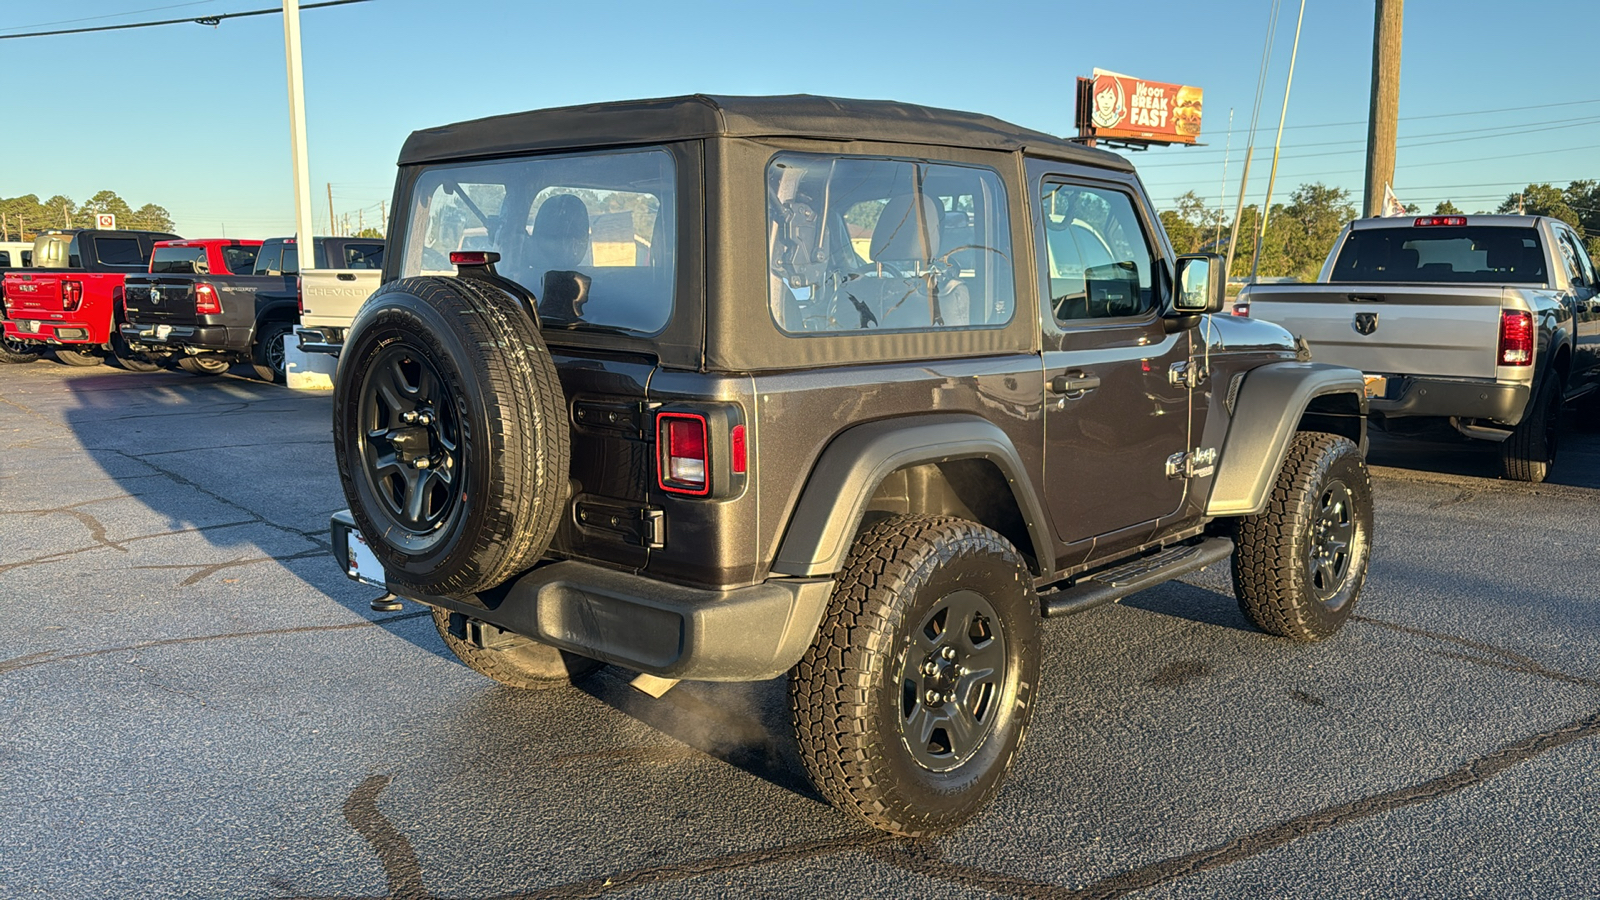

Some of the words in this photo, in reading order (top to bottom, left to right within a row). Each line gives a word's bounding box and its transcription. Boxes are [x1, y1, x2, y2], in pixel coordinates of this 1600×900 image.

[1131, 94, 1168, 110] BREAK
[1130, 107, 1168, 127] FAST
[306, 285, 369, 297] CHEVROL
[1192, 447, 1217, 465] Jeep
